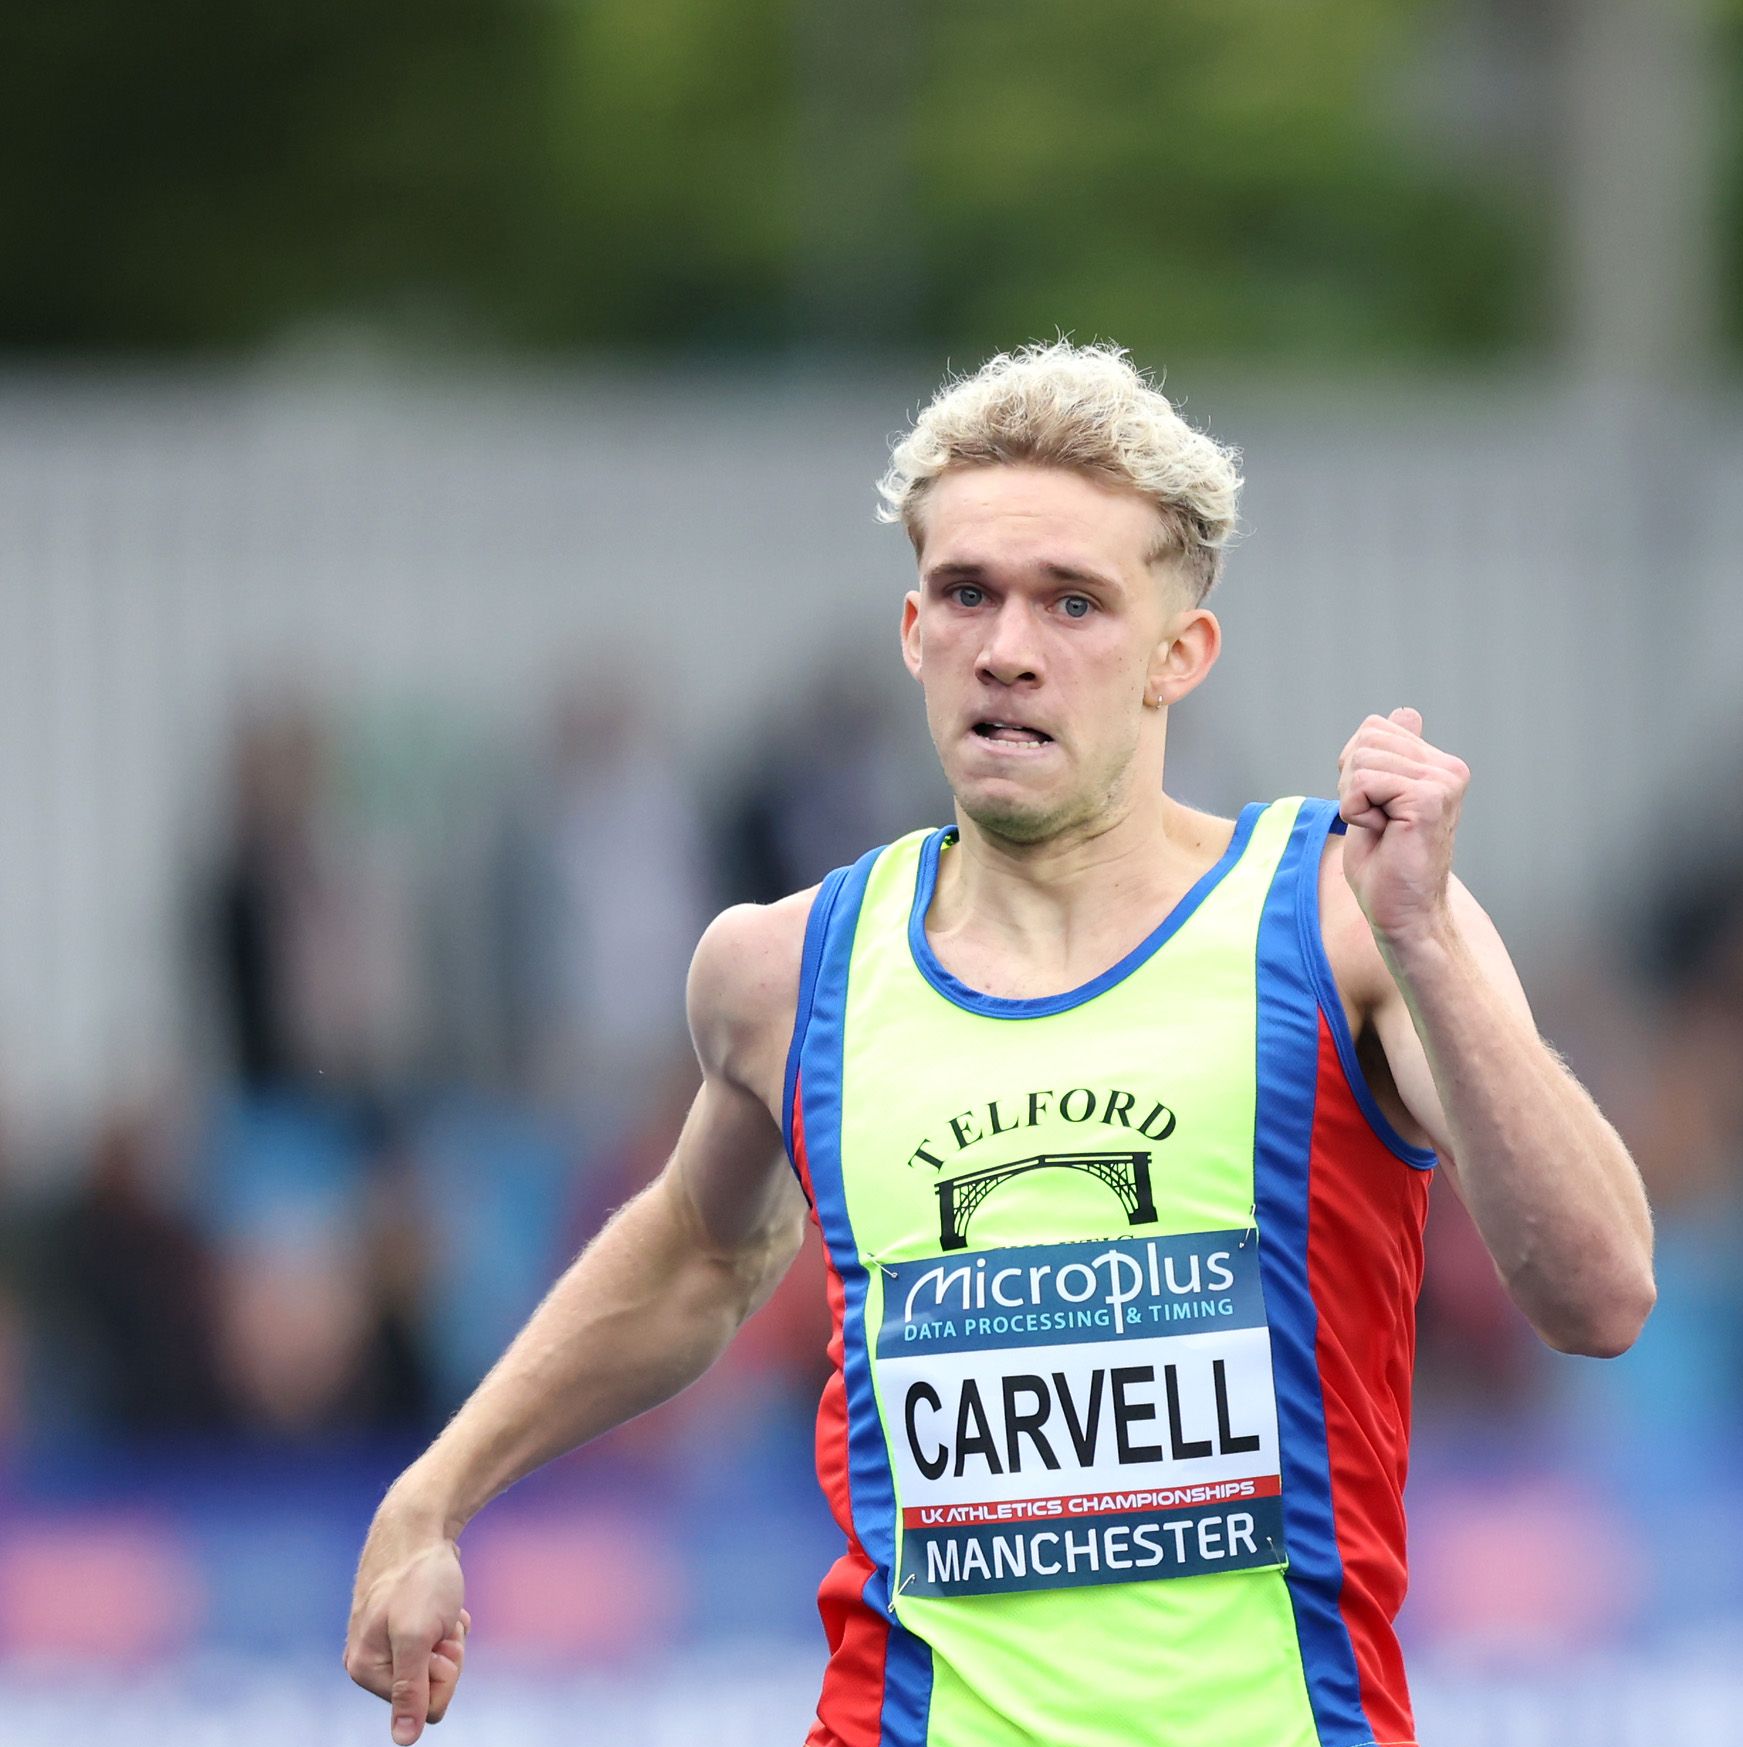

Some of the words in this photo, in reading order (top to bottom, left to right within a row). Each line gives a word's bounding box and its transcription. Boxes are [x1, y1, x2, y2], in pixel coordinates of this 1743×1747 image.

[907, 1088, 1177, 1176] TELFORD
[904, 1320, 957, 1342] DATA
[965, 1308, 1111, 1336] PROCESSING
[1126, 1309, 1143, 1325] &
[1148, 1298, 1234, 1322] TIMING
[904, 1359, 1261, 1481] CARVELL
[921, 1507, 945, 1524] UK
[945, 1499, 1063, 1523] ATHLETICS
[1067, 1480, 1256, 1513] CHAMPIONSHIPS
[926, 1512, 1259, 1583] MANCHESTER
